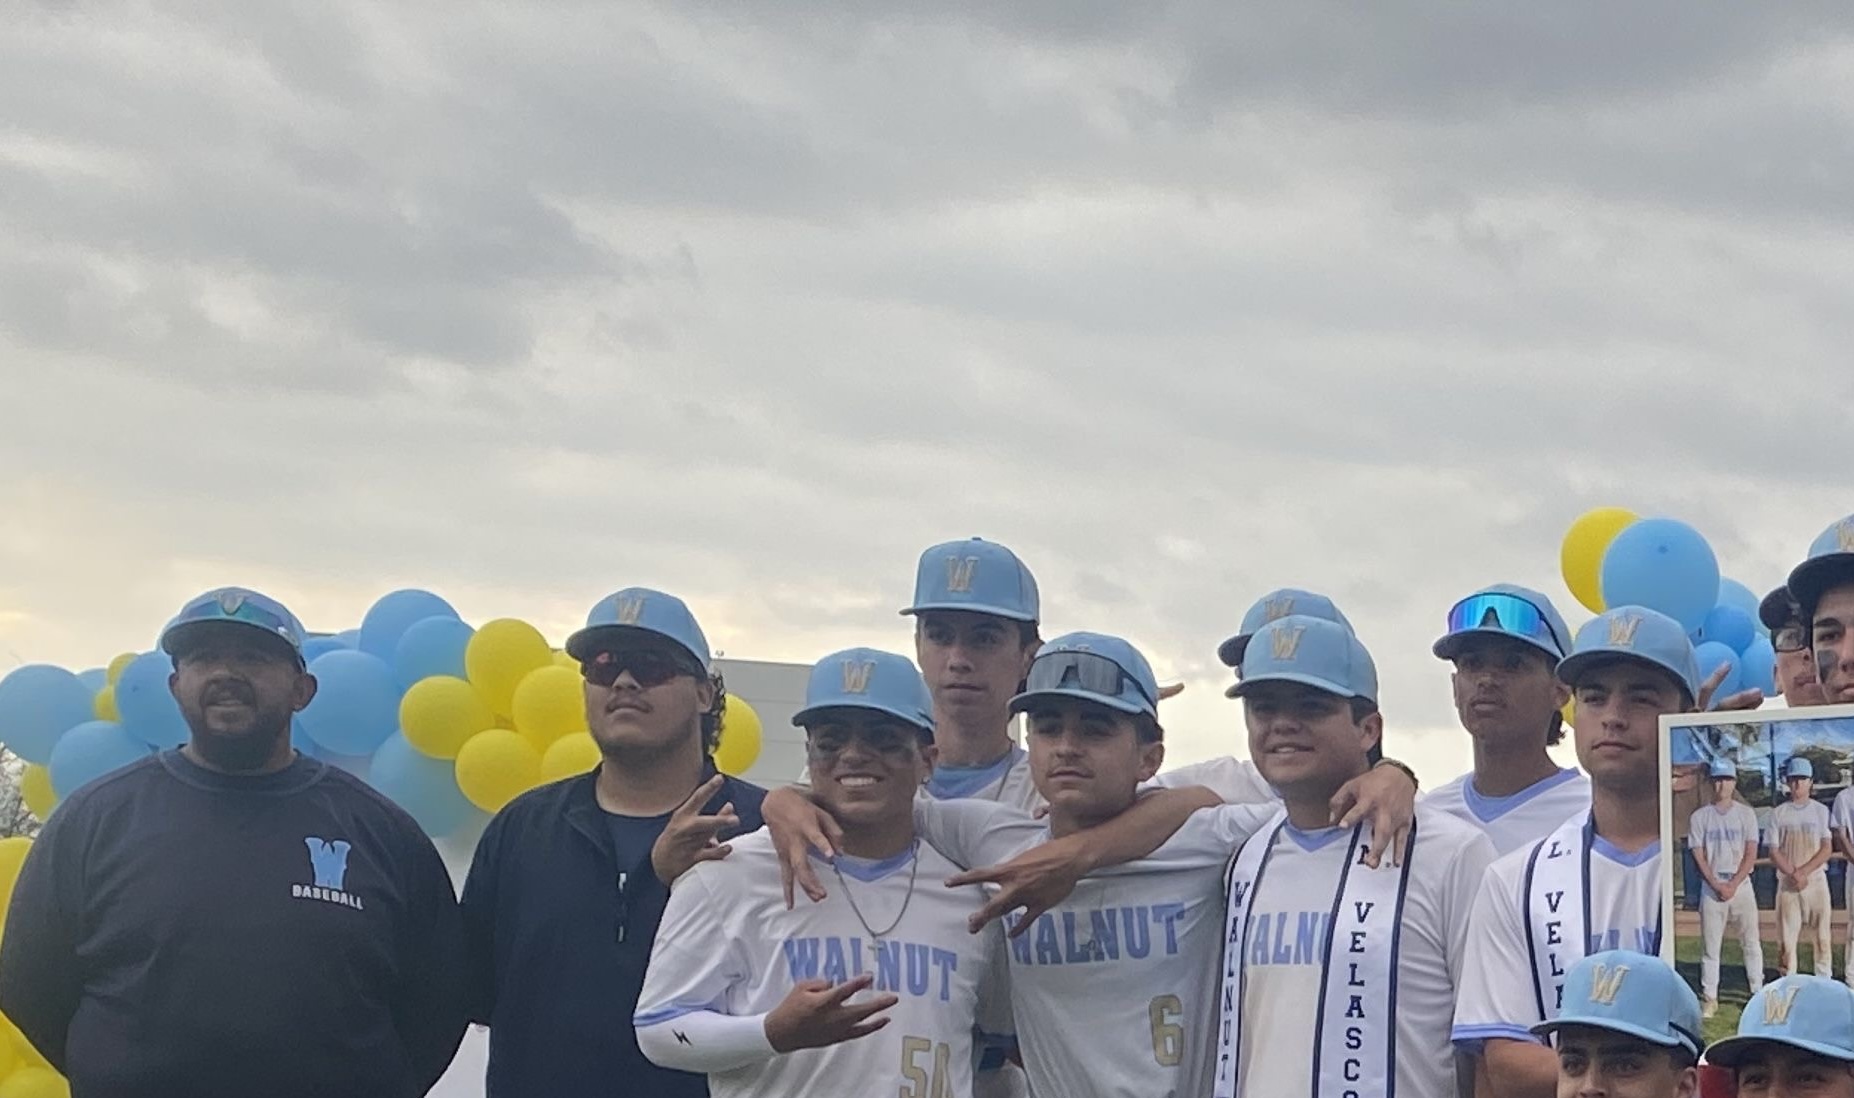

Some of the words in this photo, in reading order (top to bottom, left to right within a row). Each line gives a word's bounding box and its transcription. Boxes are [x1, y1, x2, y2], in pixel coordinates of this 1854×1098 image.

[945, 556, 979, 592] W
[1272, 627, 1306, 660] W
[1608, 616, 1642, 646] W
[841, 660, 875, 693] W
[303, 836, 352, 890] W
[292, 884, 364, 910] BASEBALL
[1588, 962, 1632, 1006] W
[1763, 985, 1801, 1026] W
[1148, 993, 1186, 1068] 6
